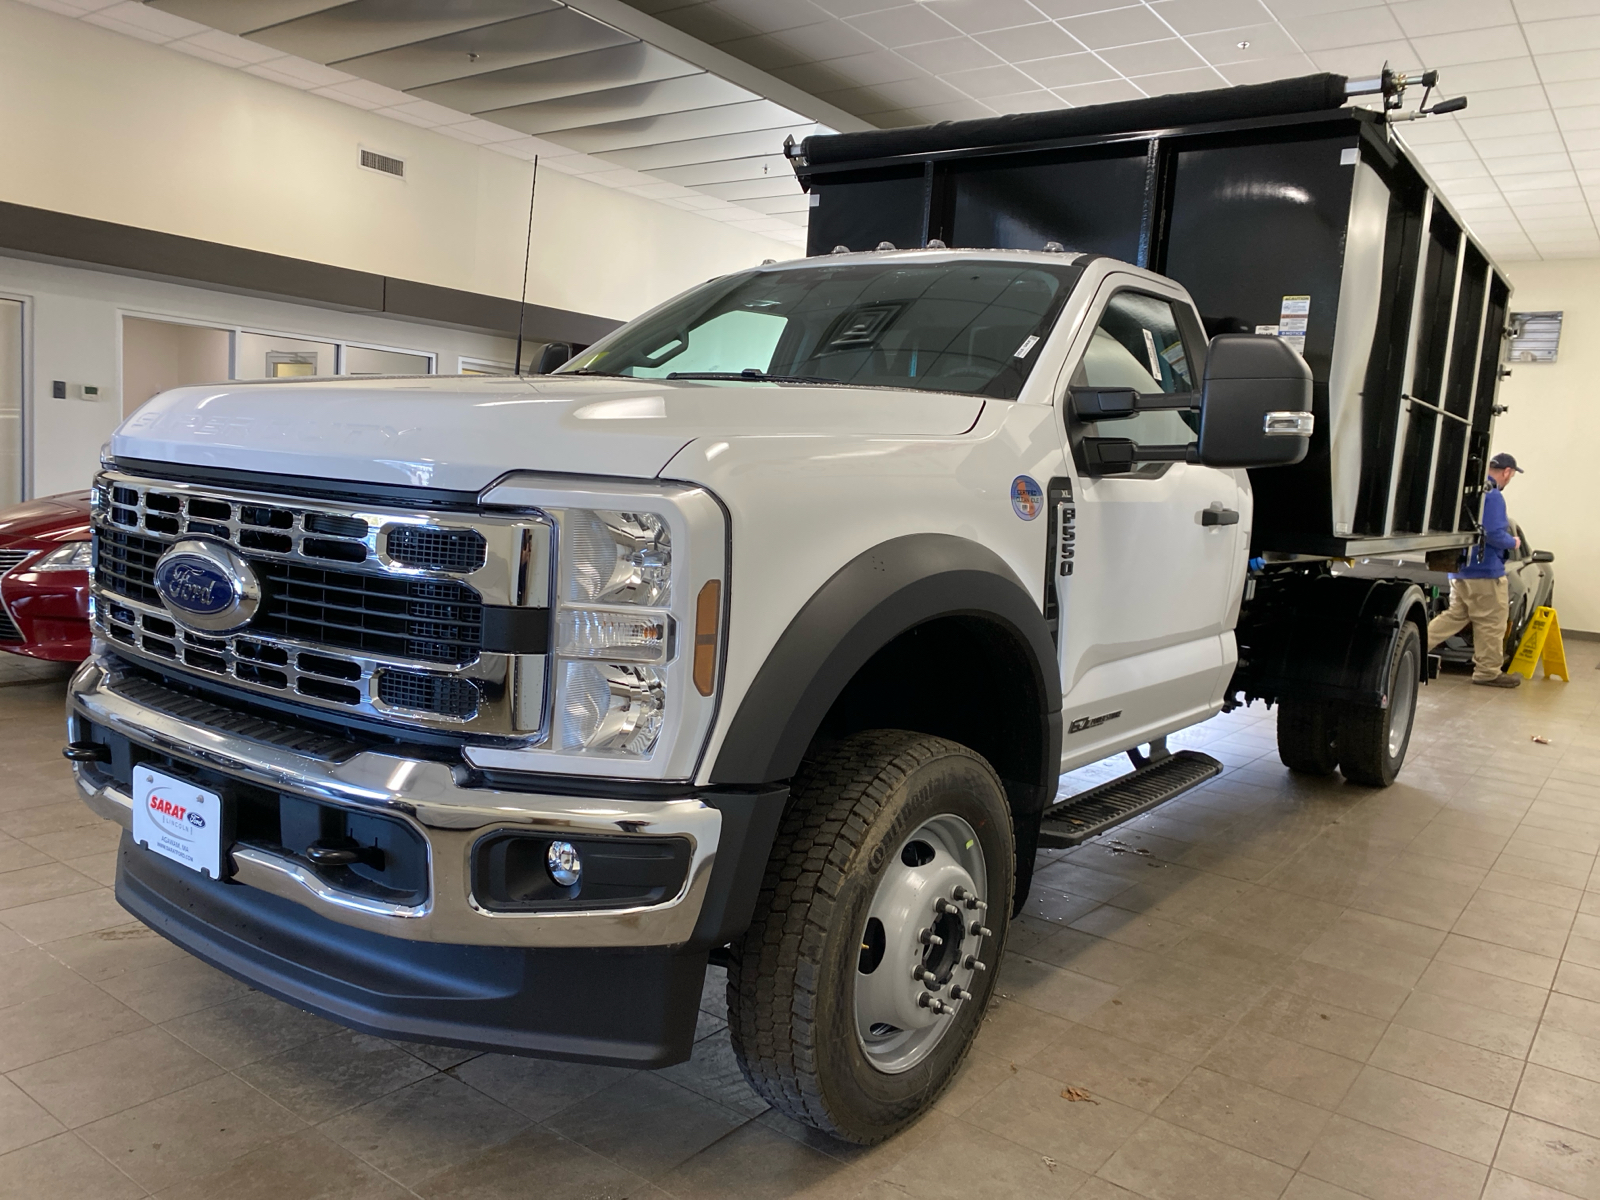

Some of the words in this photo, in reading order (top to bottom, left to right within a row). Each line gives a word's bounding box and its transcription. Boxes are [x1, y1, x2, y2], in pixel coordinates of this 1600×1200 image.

[1061, 490, 1071, 498] XL
[168, 563, 217, 606] Ford
[150, 795, 186, 820] SARAT
[166, 818, 189, 833] LINCOLN
